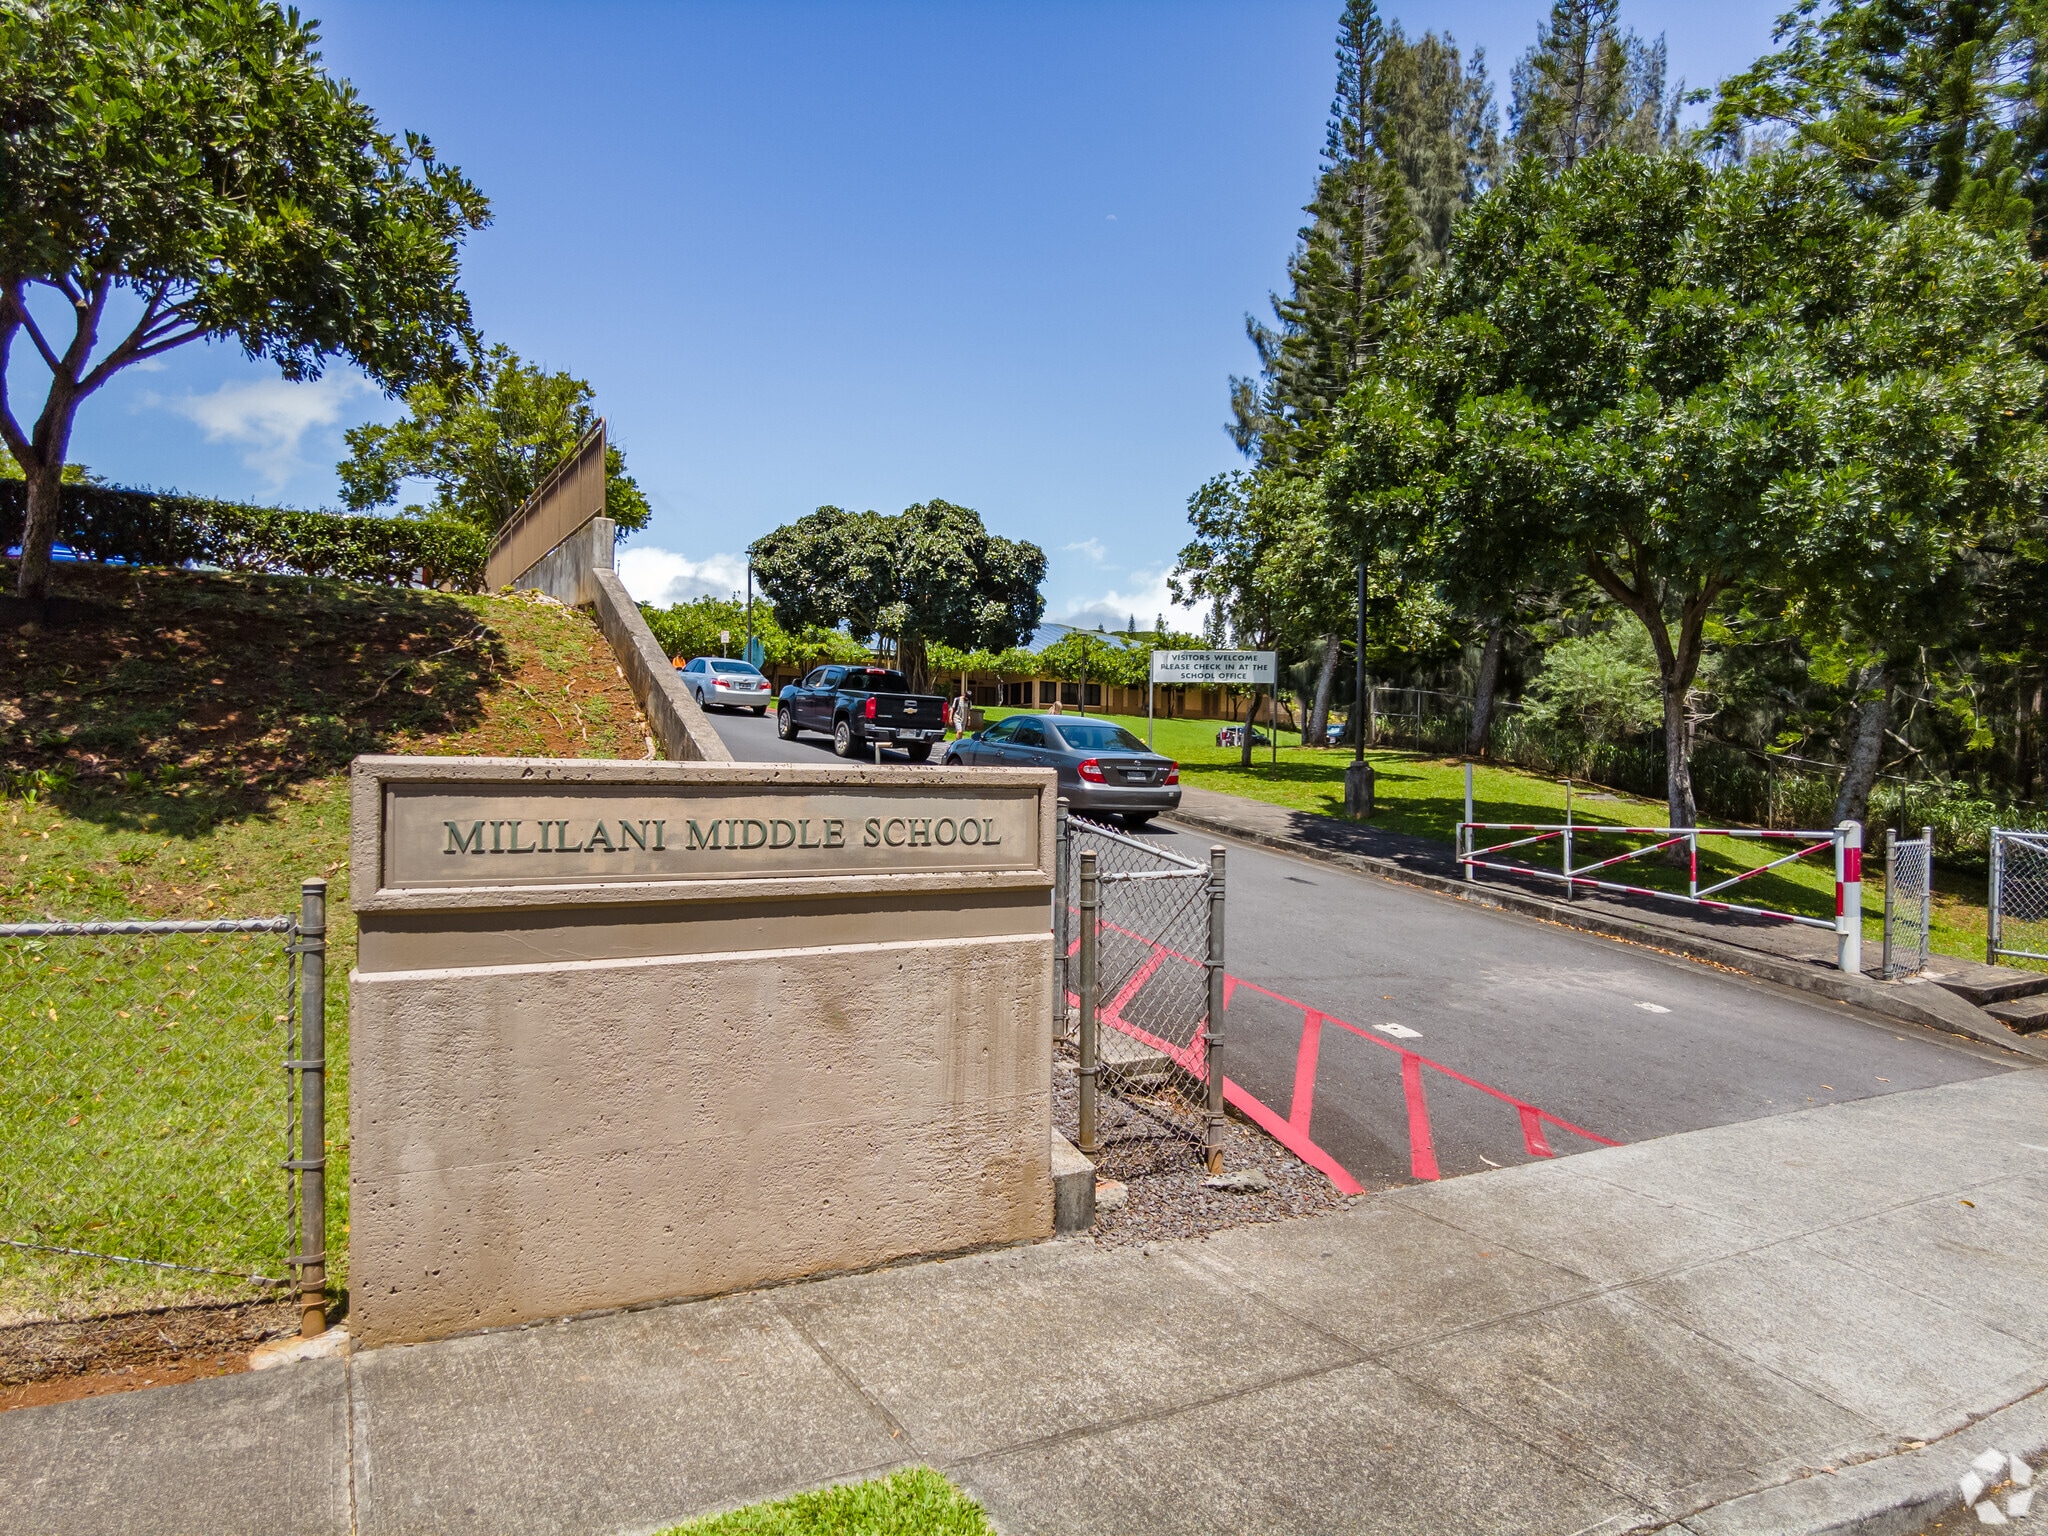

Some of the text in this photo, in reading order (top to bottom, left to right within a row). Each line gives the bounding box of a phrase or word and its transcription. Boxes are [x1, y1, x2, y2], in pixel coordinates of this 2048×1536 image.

[1214, 654, 1258, 662] WELCOME
[1218, 672, 1247, 680] OFFICE
[443, 816, 1002, 854] MILILANI MIDDLE SCHOOL
